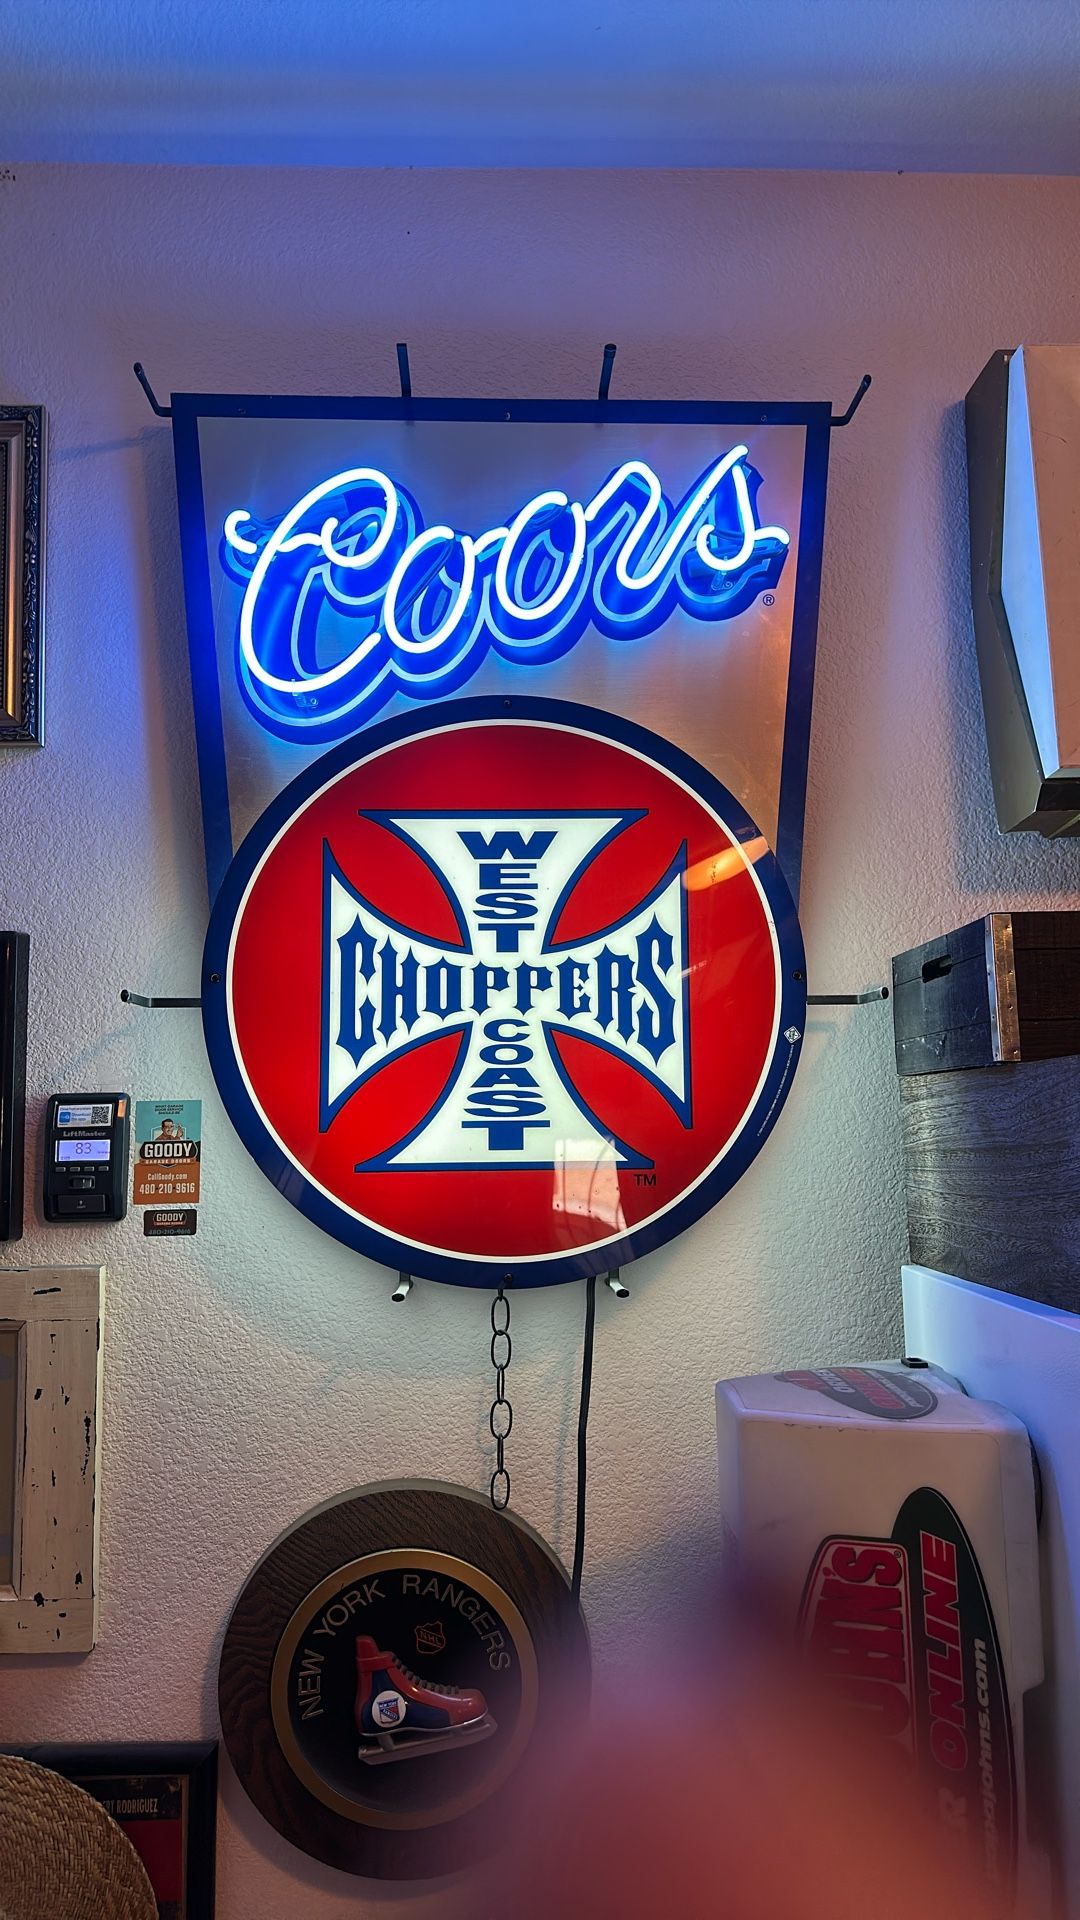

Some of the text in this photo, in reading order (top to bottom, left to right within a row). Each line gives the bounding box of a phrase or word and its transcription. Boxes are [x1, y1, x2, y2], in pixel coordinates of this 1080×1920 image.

[222, 444, 790, 728] Coors
[456, 831, 558, 953] WEST
[336, 912, 676, 1070] CHOPPERS
[461, 1018, 551, 1151] COAST
[75, 1142, 92, 1155] 83
[144, 1143, 193, 1158] GOODY
[147, 1173, 188, 1181] CallGoody.com
[156, 1213, 184, 1222] GOODY
[298, 1574, 511, 1721] NEW YORK RANGERS
[420, 1630, 442, 1646] NHL
[920, 1530, 969, 1771] ONLINE
[116, 1798, 158, 1814] RODRIGUEZ
